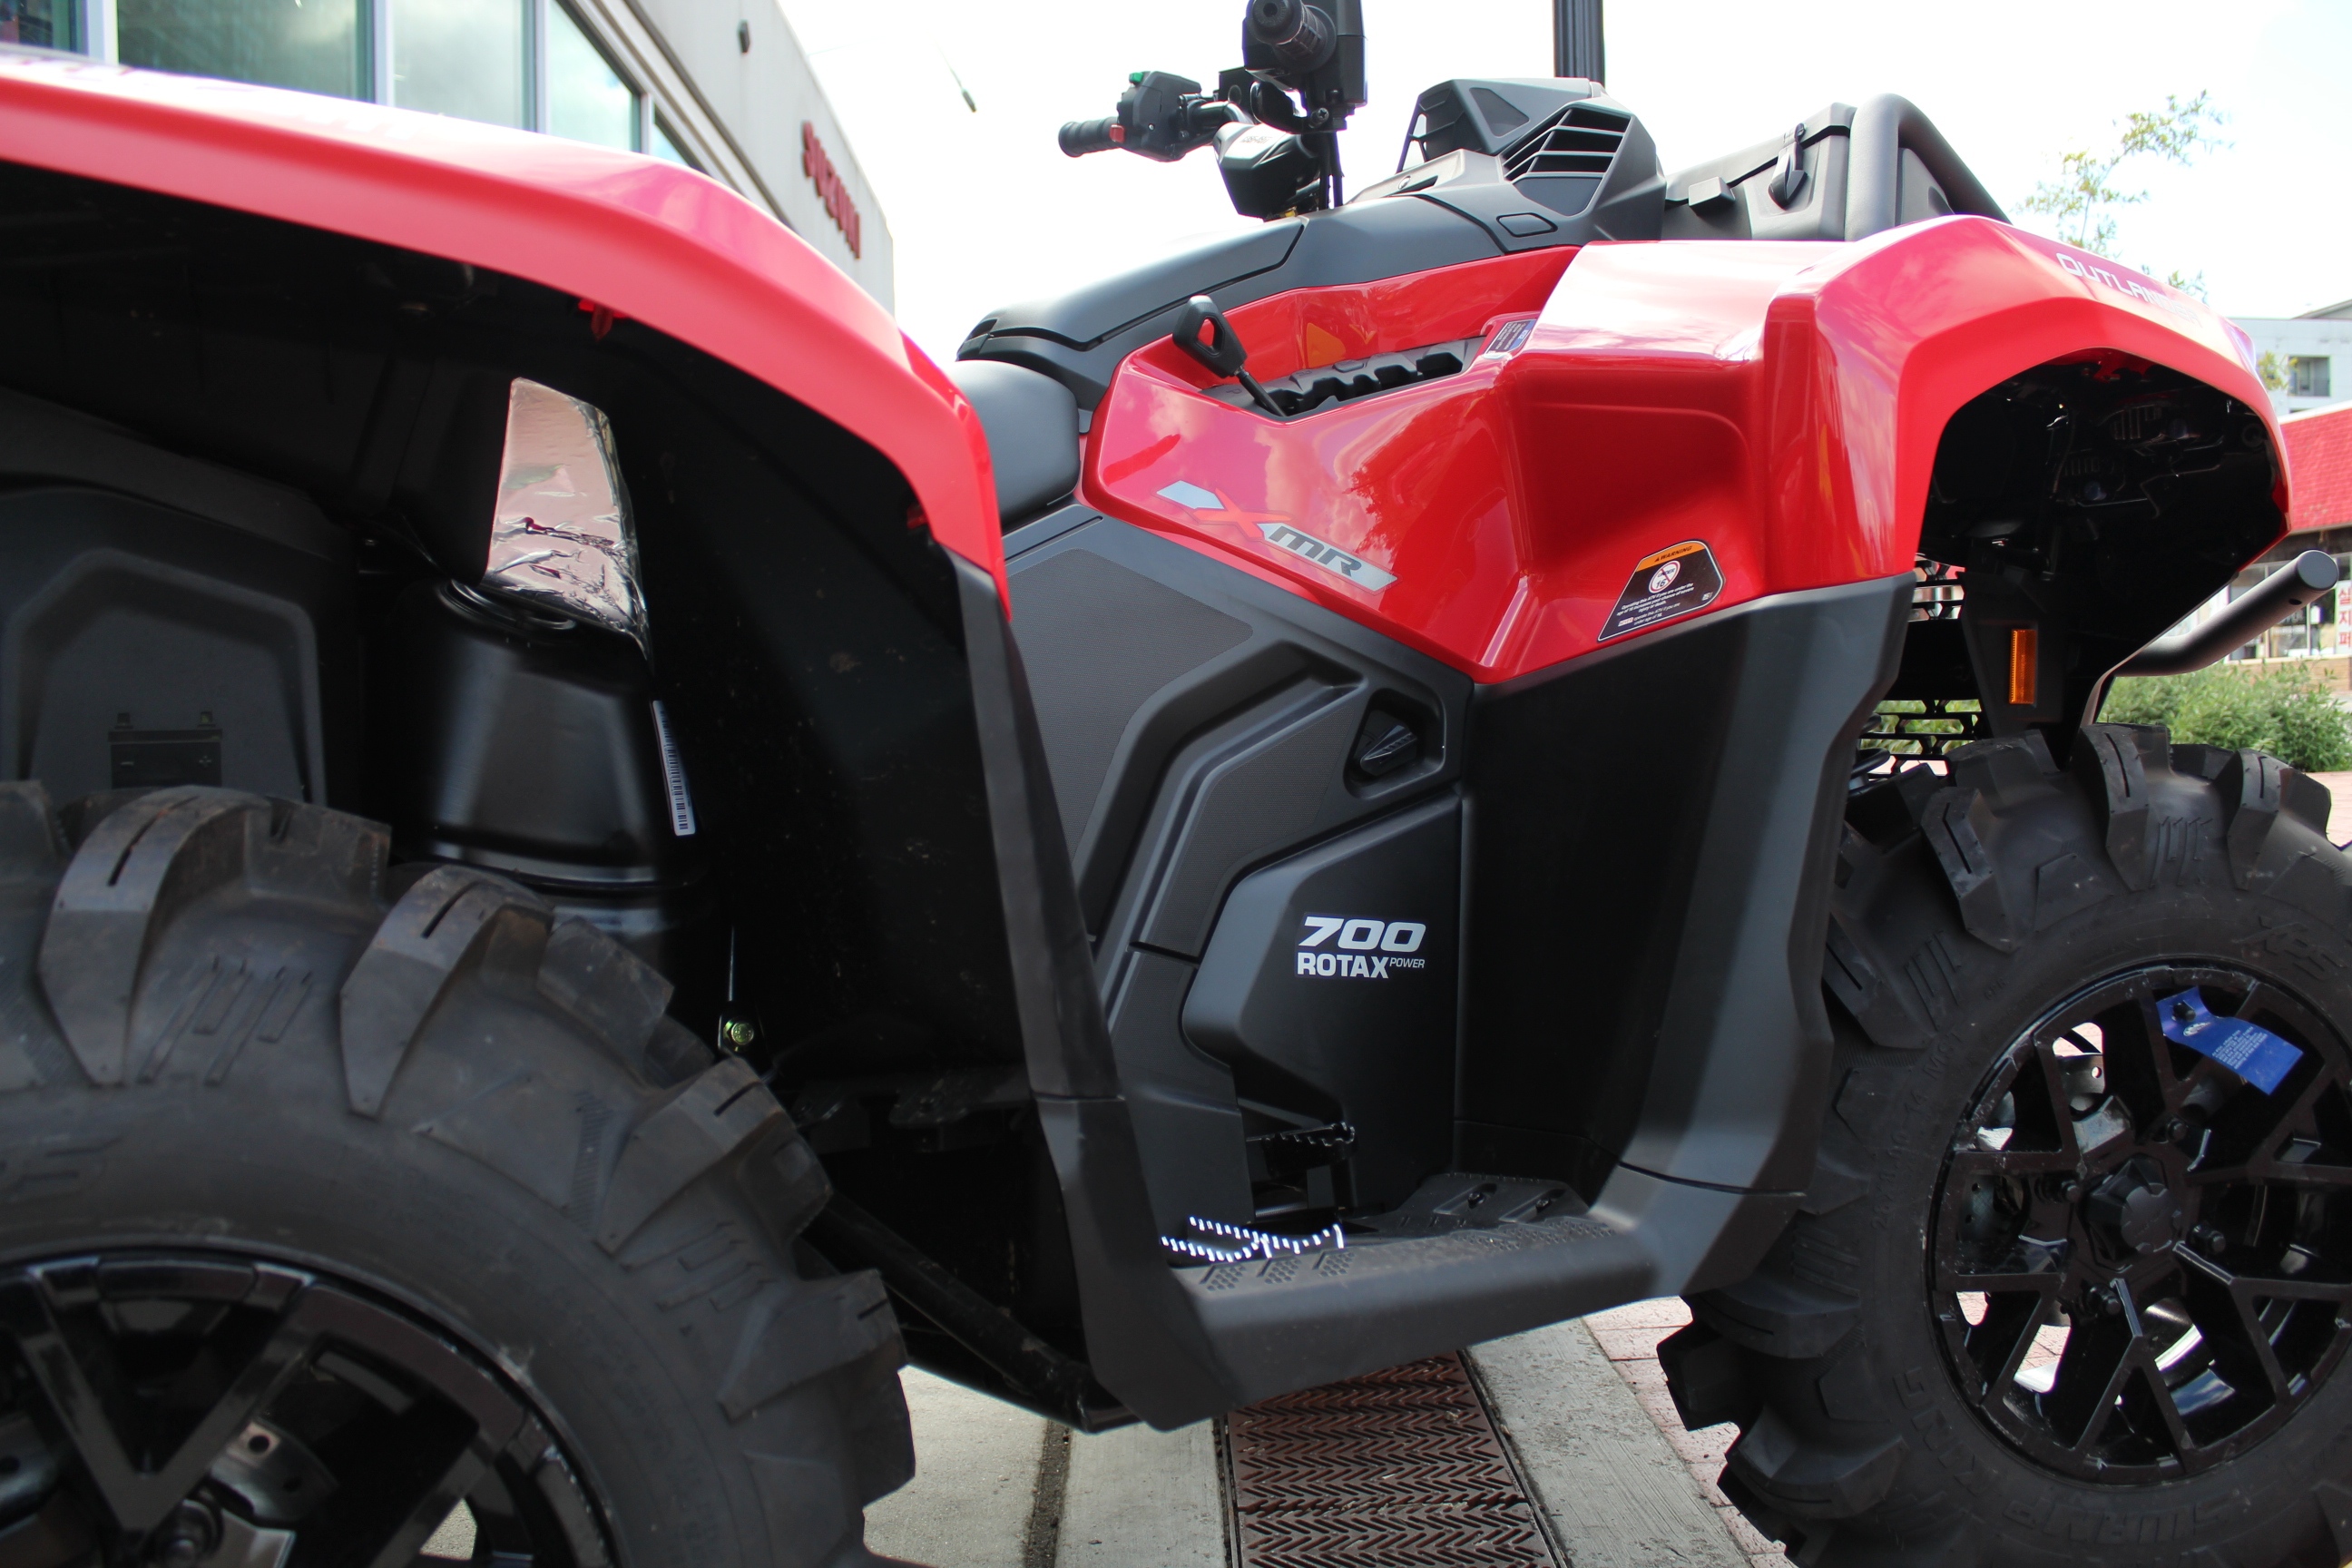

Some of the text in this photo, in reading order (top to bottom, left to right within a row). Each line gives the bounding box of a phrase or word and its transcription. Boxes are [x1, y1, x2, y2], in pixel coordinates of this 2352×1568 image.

[2055, 252, 2204, 328] OUTLANDER
[1660, 545, 1693, 561] WARNING
[1298, 916, 1426, 953] 700
[1297, 951, 1426, 979] ROTAX POWER
